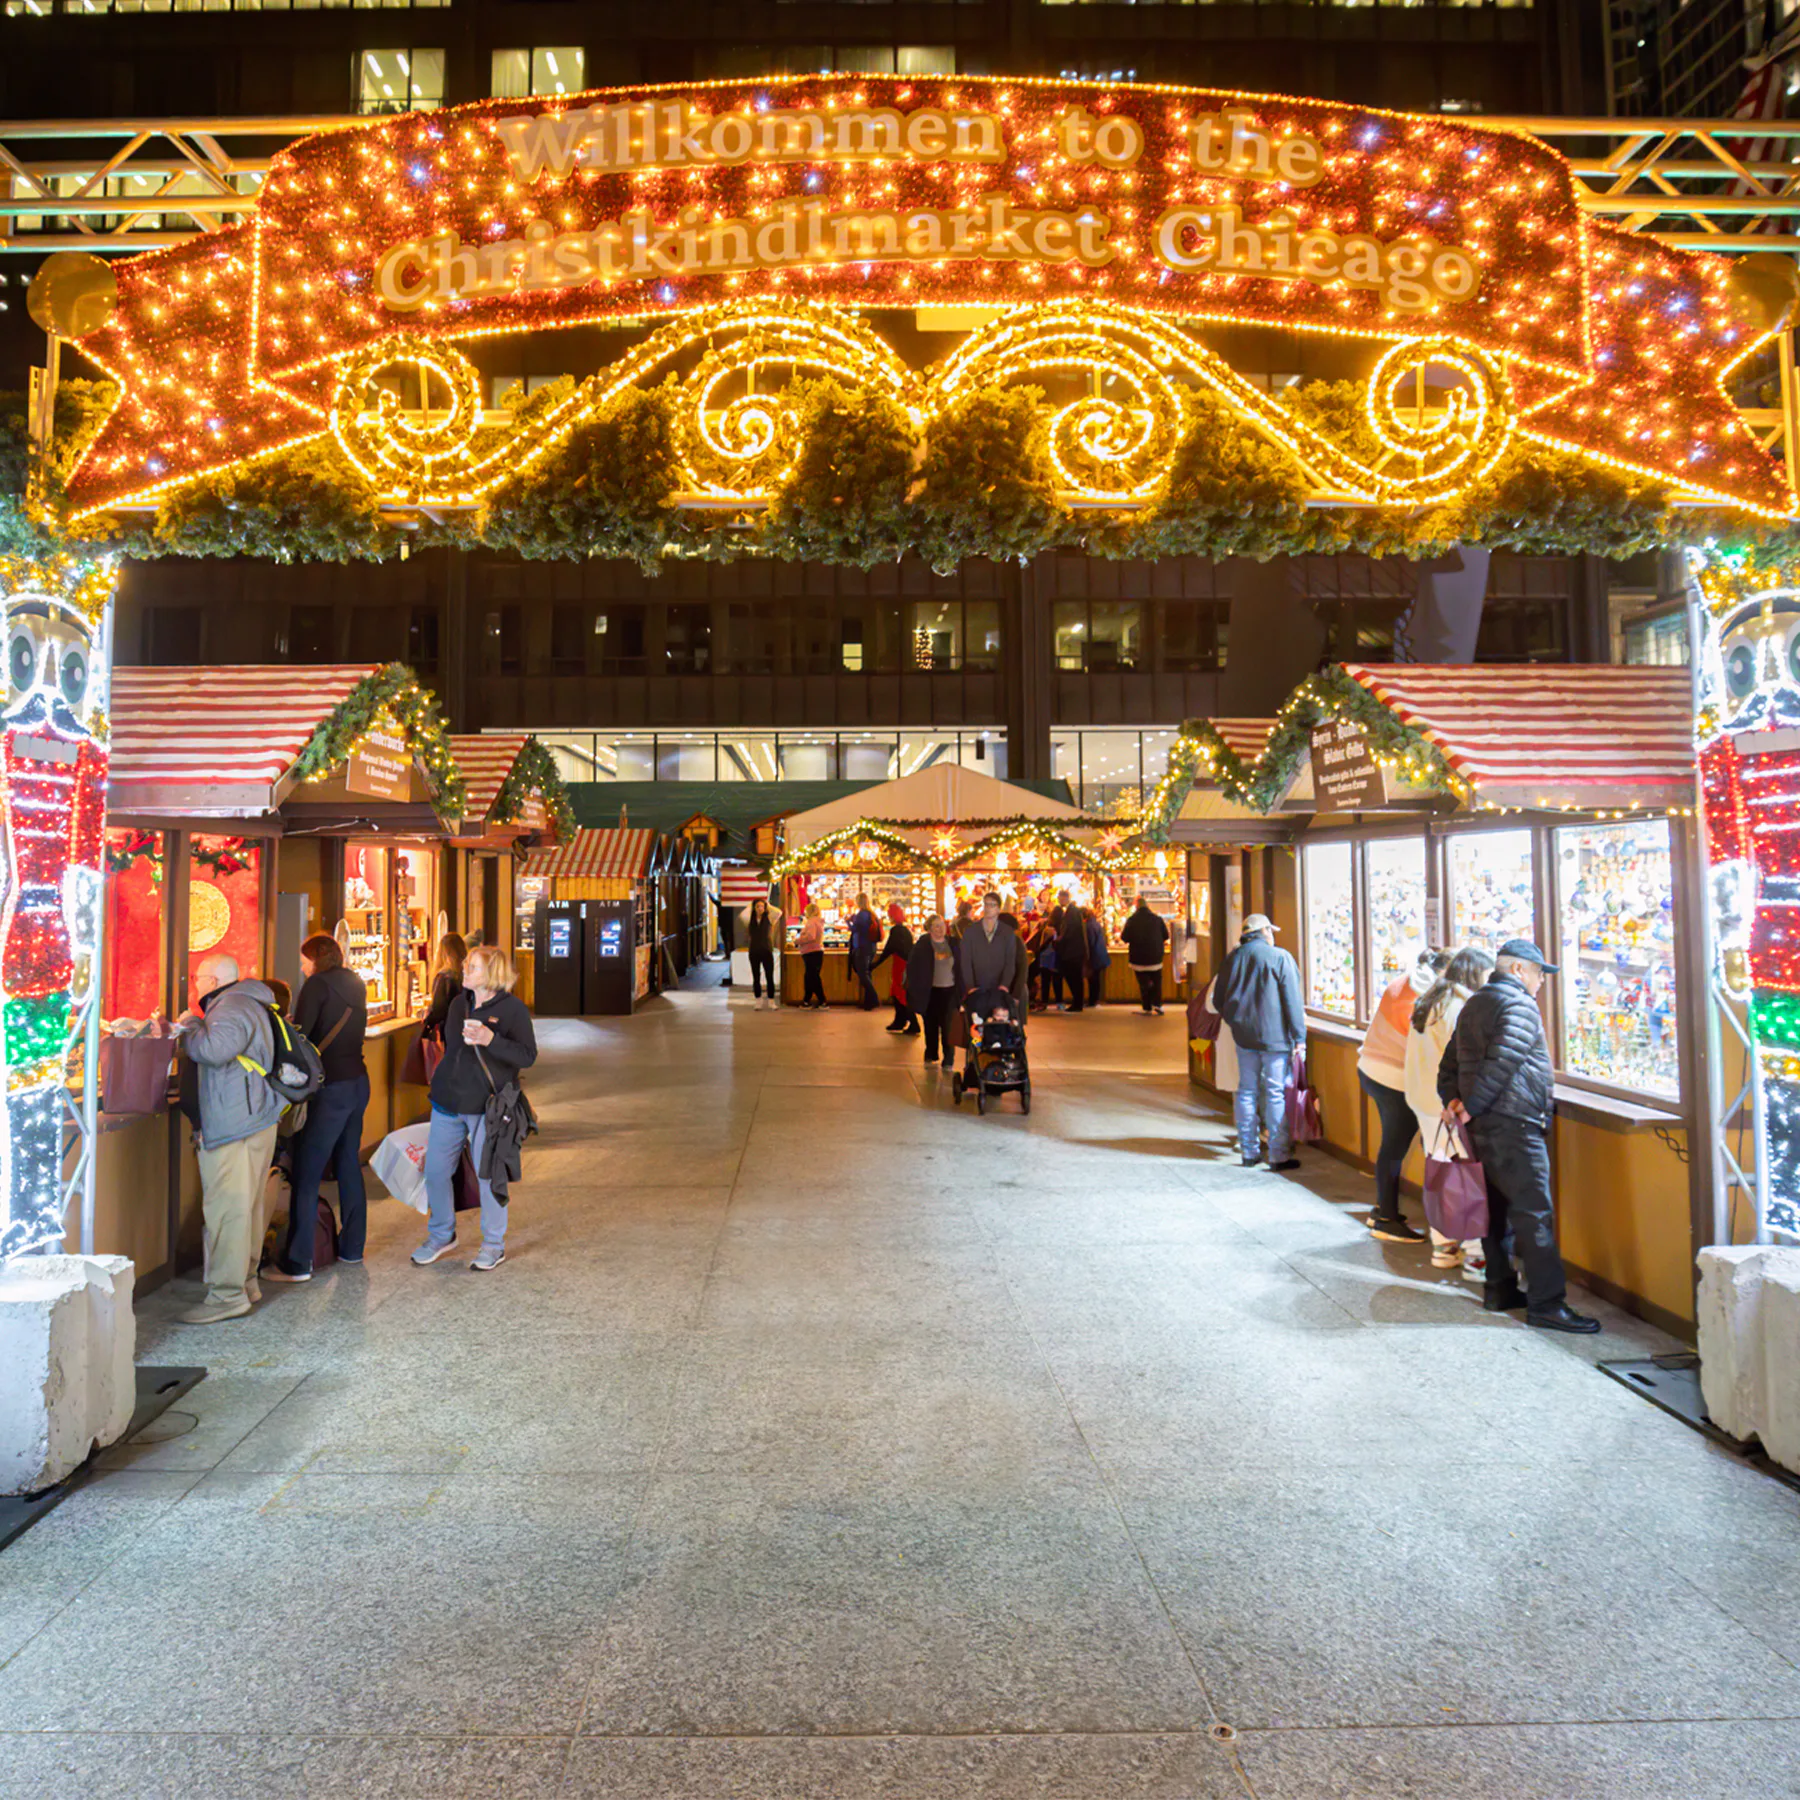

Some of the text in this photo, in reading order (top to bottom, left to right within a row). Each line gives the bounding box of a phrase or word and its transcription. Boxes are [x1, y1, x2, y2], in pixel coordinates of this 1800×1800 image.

[499, 104, 1319, 181] Willkommen to the
[379, 197, 1474, 309] Christkindlmarket Chicago
[548, 900, 570, 909] ATM
[600, 900, 620, 909] ATM
